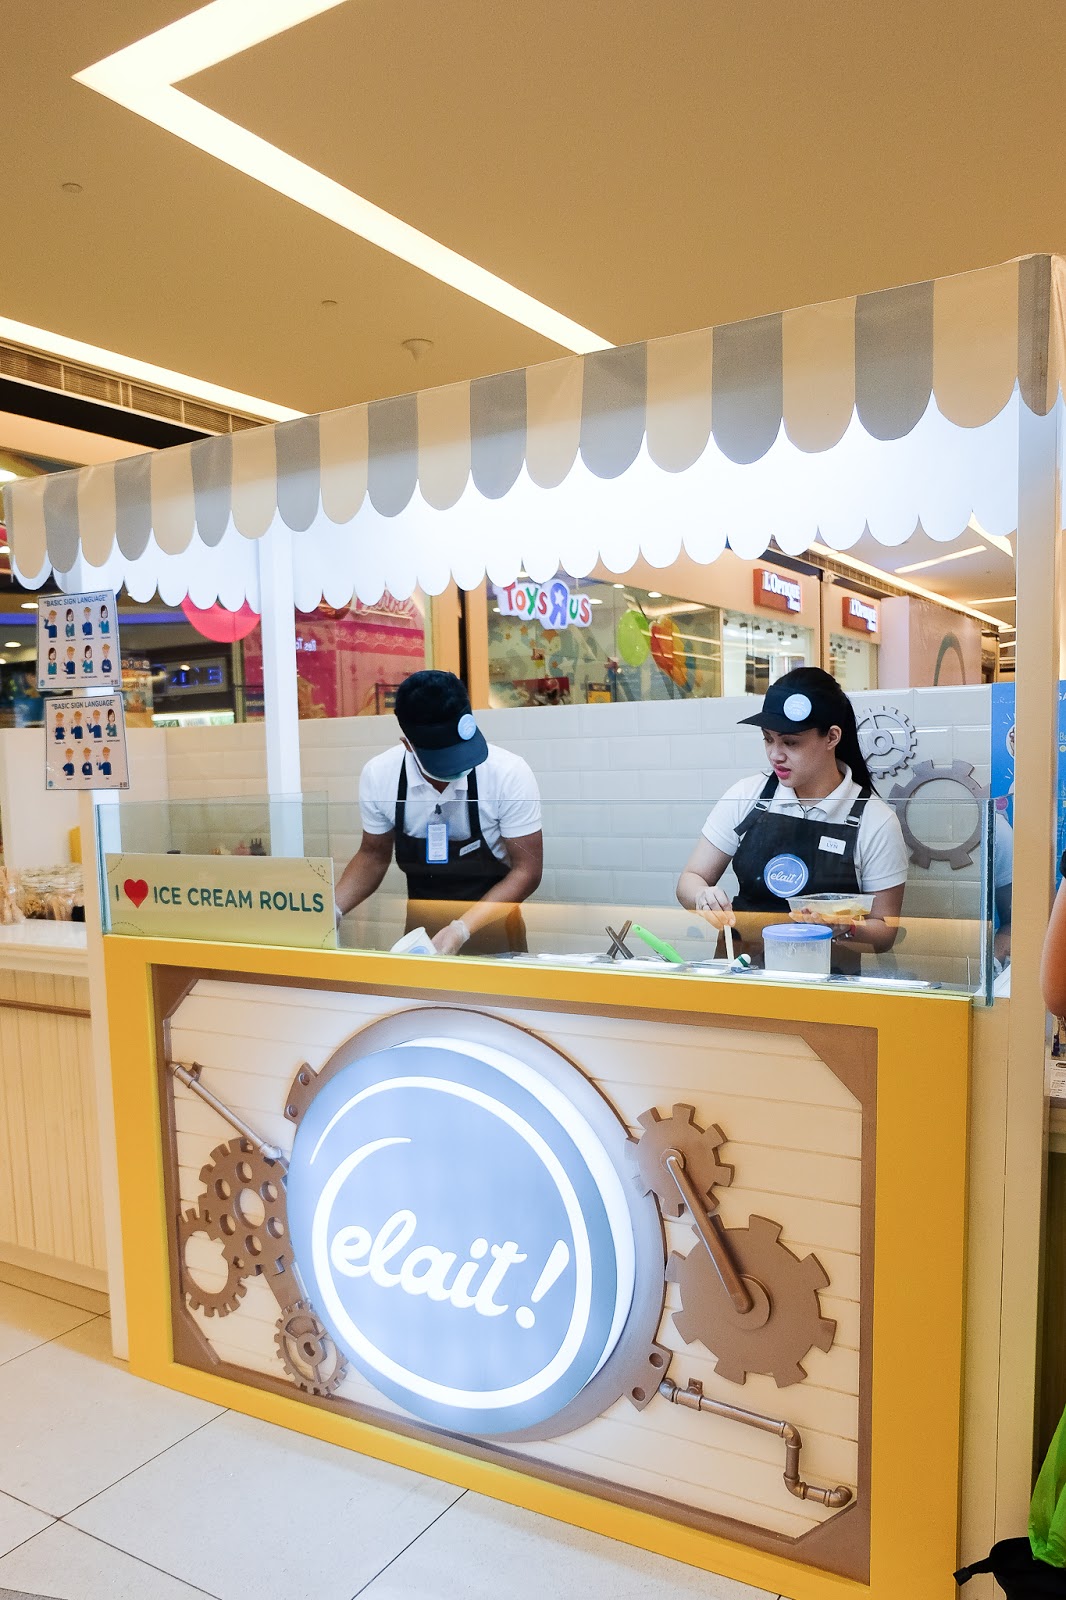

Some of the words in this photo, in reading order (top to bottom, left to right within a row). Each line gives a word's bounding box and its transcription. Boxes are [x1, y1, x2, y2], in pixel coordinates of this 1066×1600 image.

[64, 598, 77, 606] SIGN
[115, 884, 120, 902] I
[153, 886, 181, 905] ICE
[187, 888, 252, 909] CREAM
[259, 890, 325, 913] ROLLS
